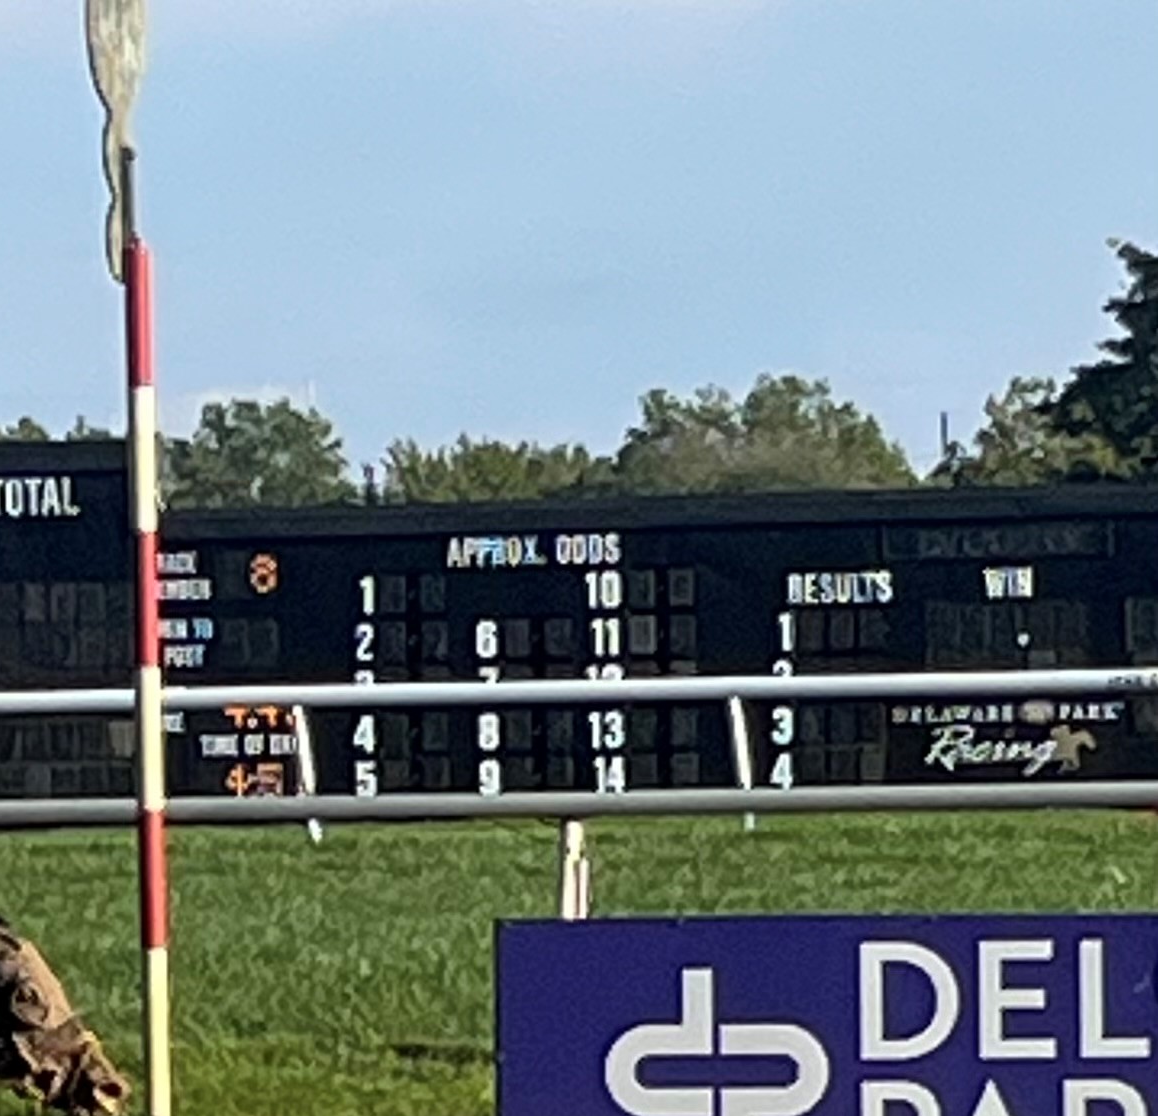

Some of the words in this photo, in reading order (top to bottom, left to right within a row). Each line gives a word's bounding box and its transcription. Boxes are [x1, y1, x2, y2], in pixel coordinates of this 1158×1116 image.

[447, 536, 547, 568] APPROX.
[556, 533, 621, 565] ODDS
[250, 553, 278, 594] 8
[585, 570, 621, 609] 10
[787, 570, 894, 604] RESULTS
[983, 565, 1034, 598] WIN
[359, 575, 375, 616] 1
[354, 623, 374, 661] 2
[476, 619, 498, 658] 6
[592, 618, 621, 657] 11
[778, 611, 795, 652] 1
[478, 711, 500, 751] 8
[588, 710, 625, 749] 13
[770, 706, 794, 745] 3
[891, 703, 1015, 724] DELAWARE
[1058, 701, 1122, 720] PARK
[353, 714, 376, 754] 4
[924, 724, 1058, 777] Racing
[355, 761, 377, 798] 5
[478, 759, 501, 796] 9
[592, 756, 626, 795] 14
[769, 753, 793, 790] 4
[859, 938, 1151, 1060] DEL
